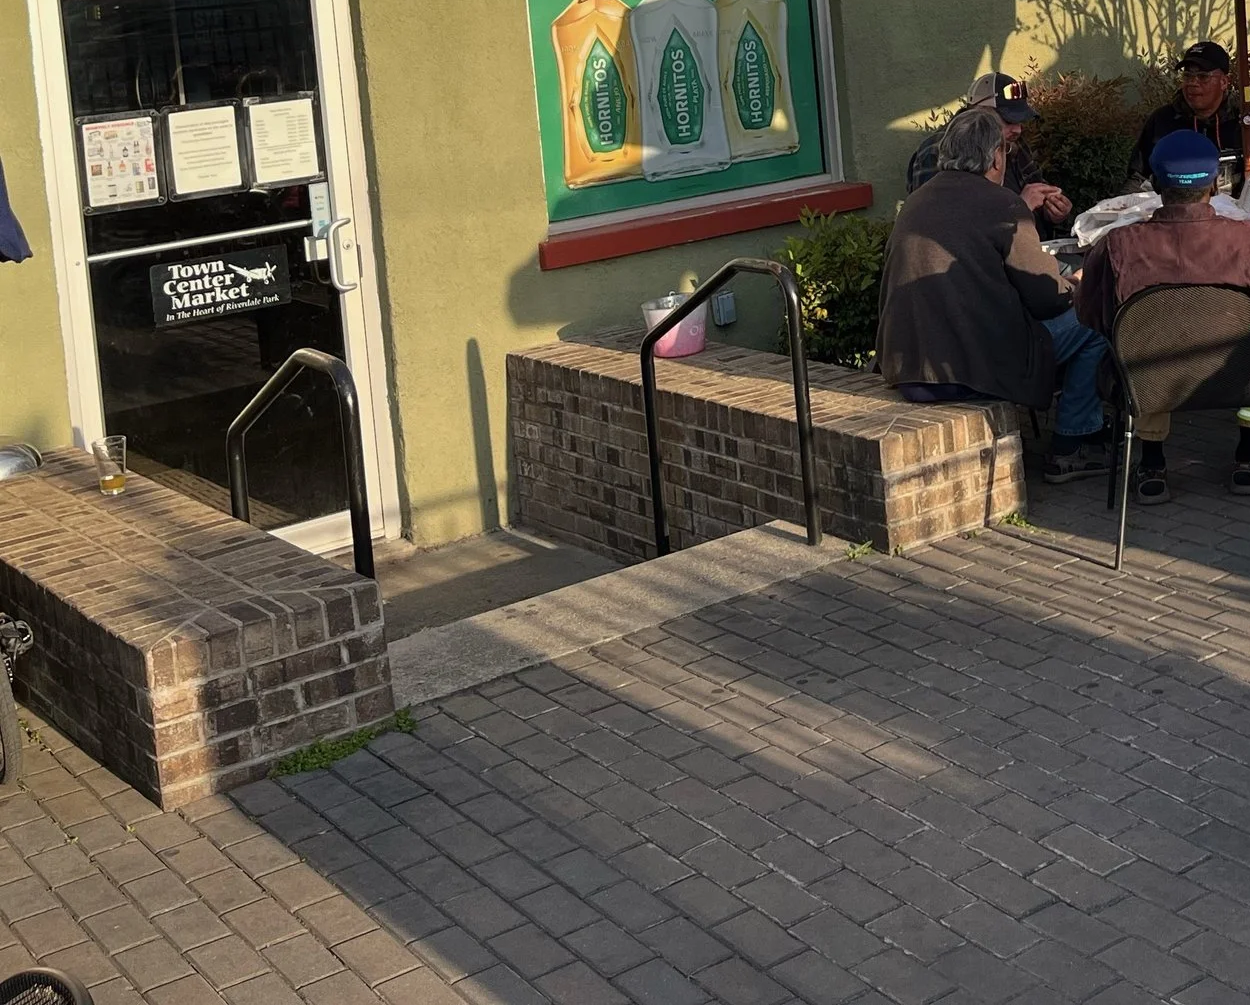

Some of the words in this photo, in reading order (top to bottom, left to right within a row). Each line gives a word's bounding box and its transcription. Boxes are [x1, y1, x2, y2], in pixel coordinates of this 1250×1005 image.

[671, 49, 691, 137] HORNITOS
[744, 40, 763, 123] HORNITOS
[593, 58, 614, 145] HORNITOS
[163, 272, 235, 296] Center
[168, 260, 226, 280] Town
[166, 313, 175, 322] In
[176, 310, 191, 321] The
[192, 306, 215, 317] Heart
[216, 303, 226, 314] of
[226, 298, 261, 311] Riverdale
[262, 293, 280, 304] Park
[171, 282, 250, 310] Market
